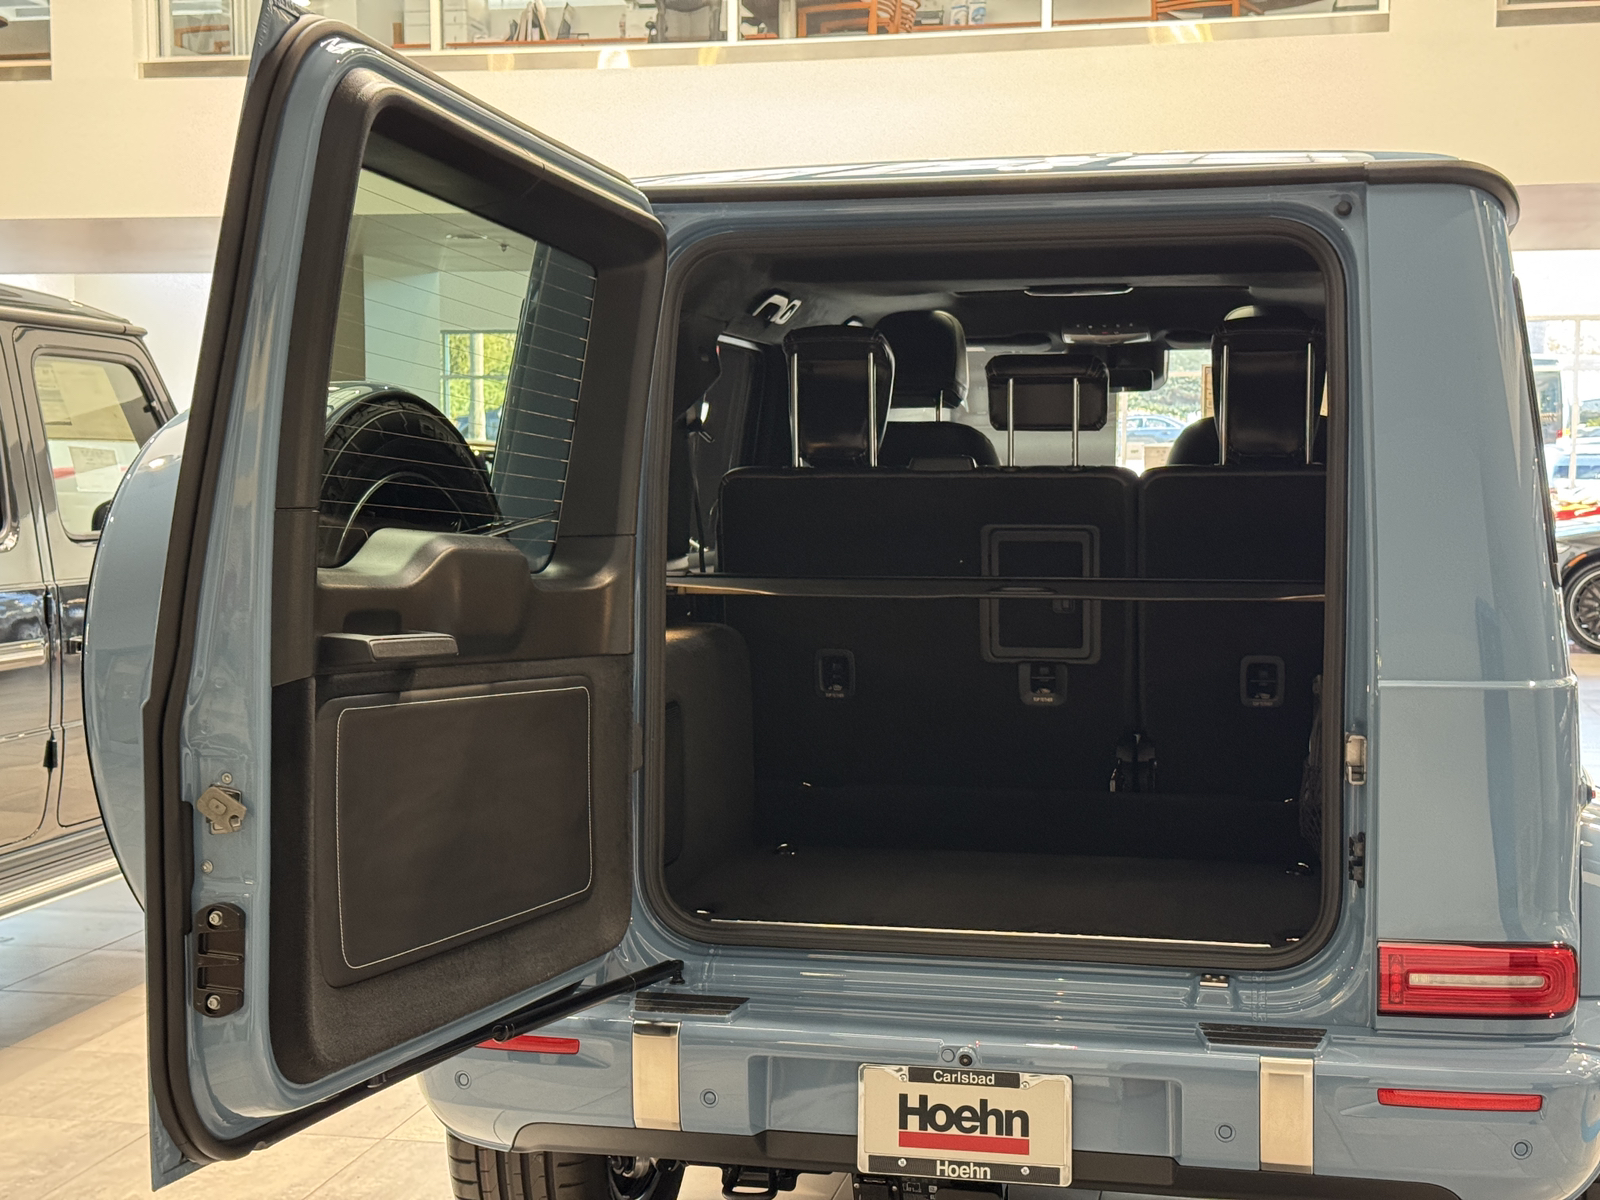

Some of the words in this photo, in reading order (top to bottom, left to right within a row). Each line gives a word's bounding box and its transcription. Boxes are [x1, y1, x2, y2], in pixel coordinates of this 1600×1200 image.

[933, 1070, 995, 1086] Carlsbad
[899, 1094, 1029, 1137] Hoehn
[936, 1160, 991, 1180] Hoehn
